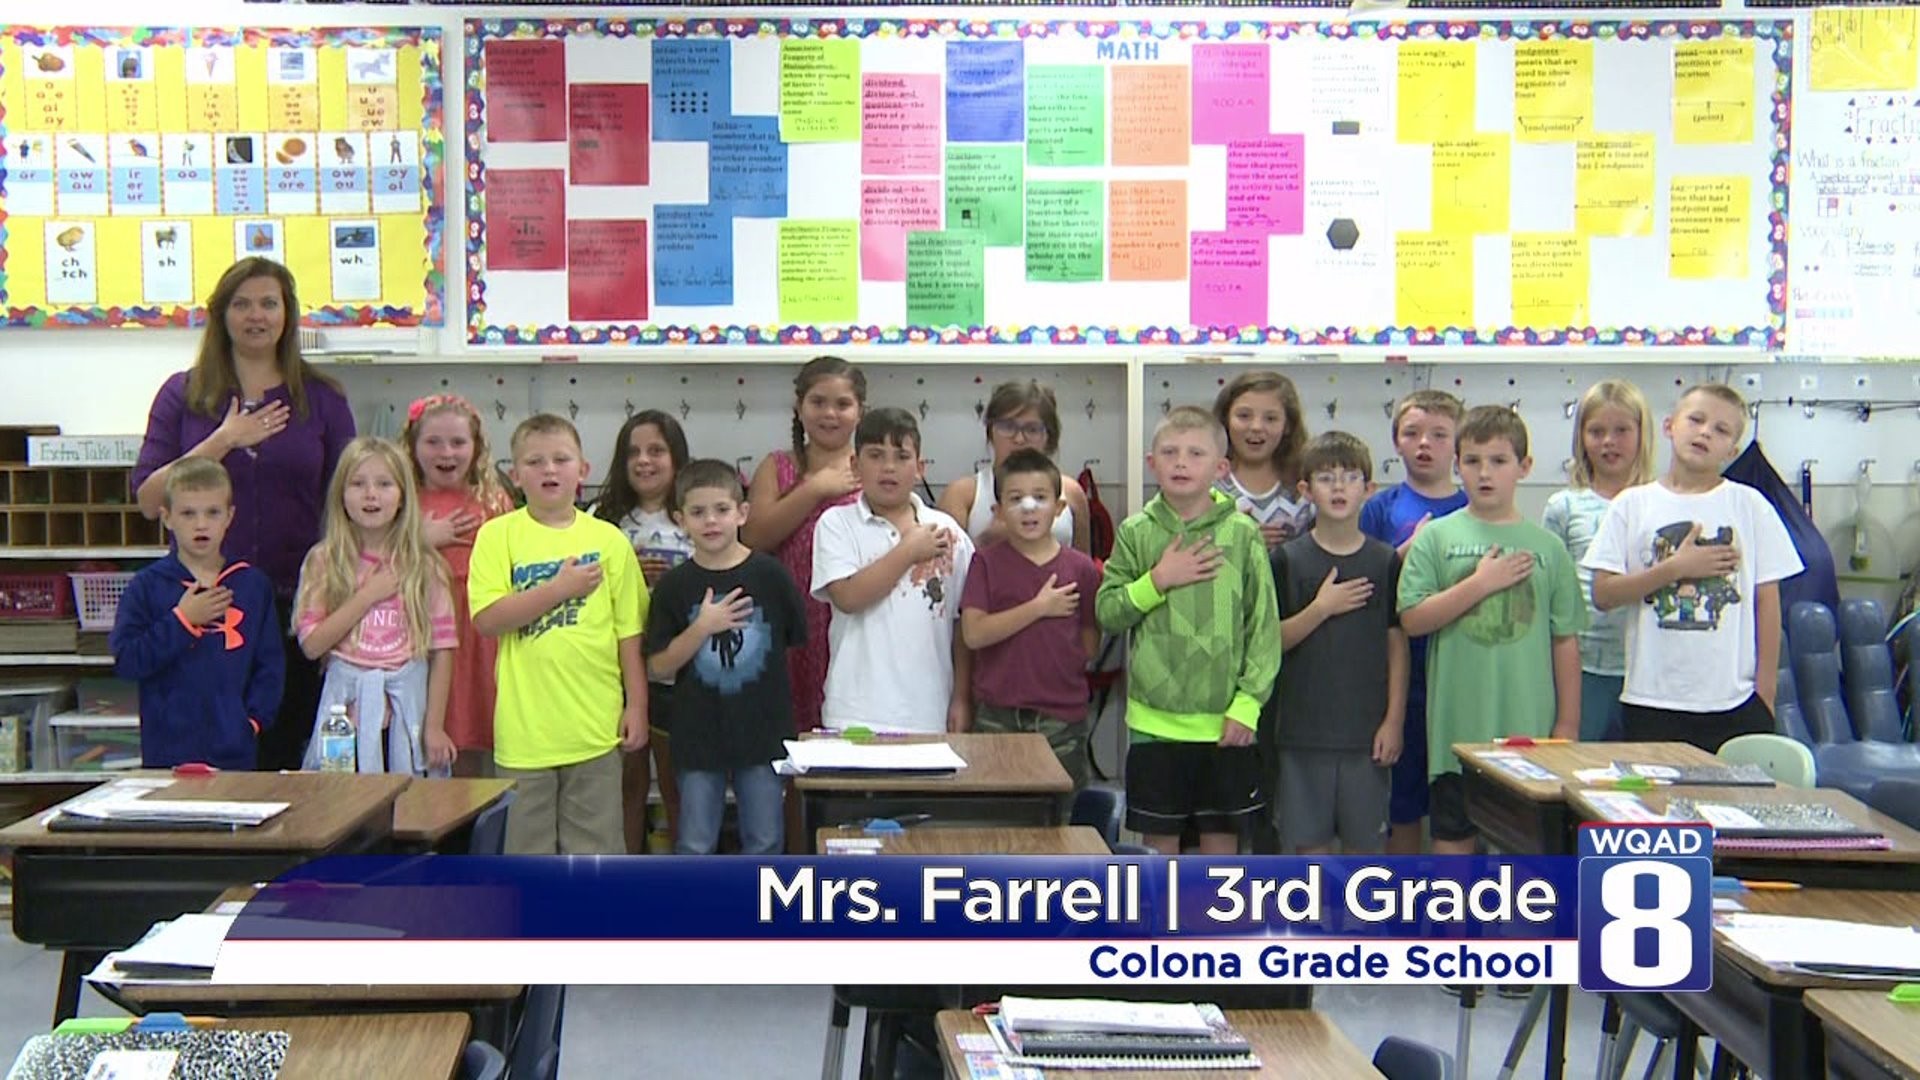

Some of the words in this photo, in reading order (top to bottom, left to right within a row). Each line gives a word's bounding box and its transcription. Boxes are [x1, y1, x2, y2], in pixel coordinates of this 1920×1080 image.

[1097, 41, 1160, 60] MATH
[41, 442, 79, 461] Extra
[78, 440, 110, 460] Take
